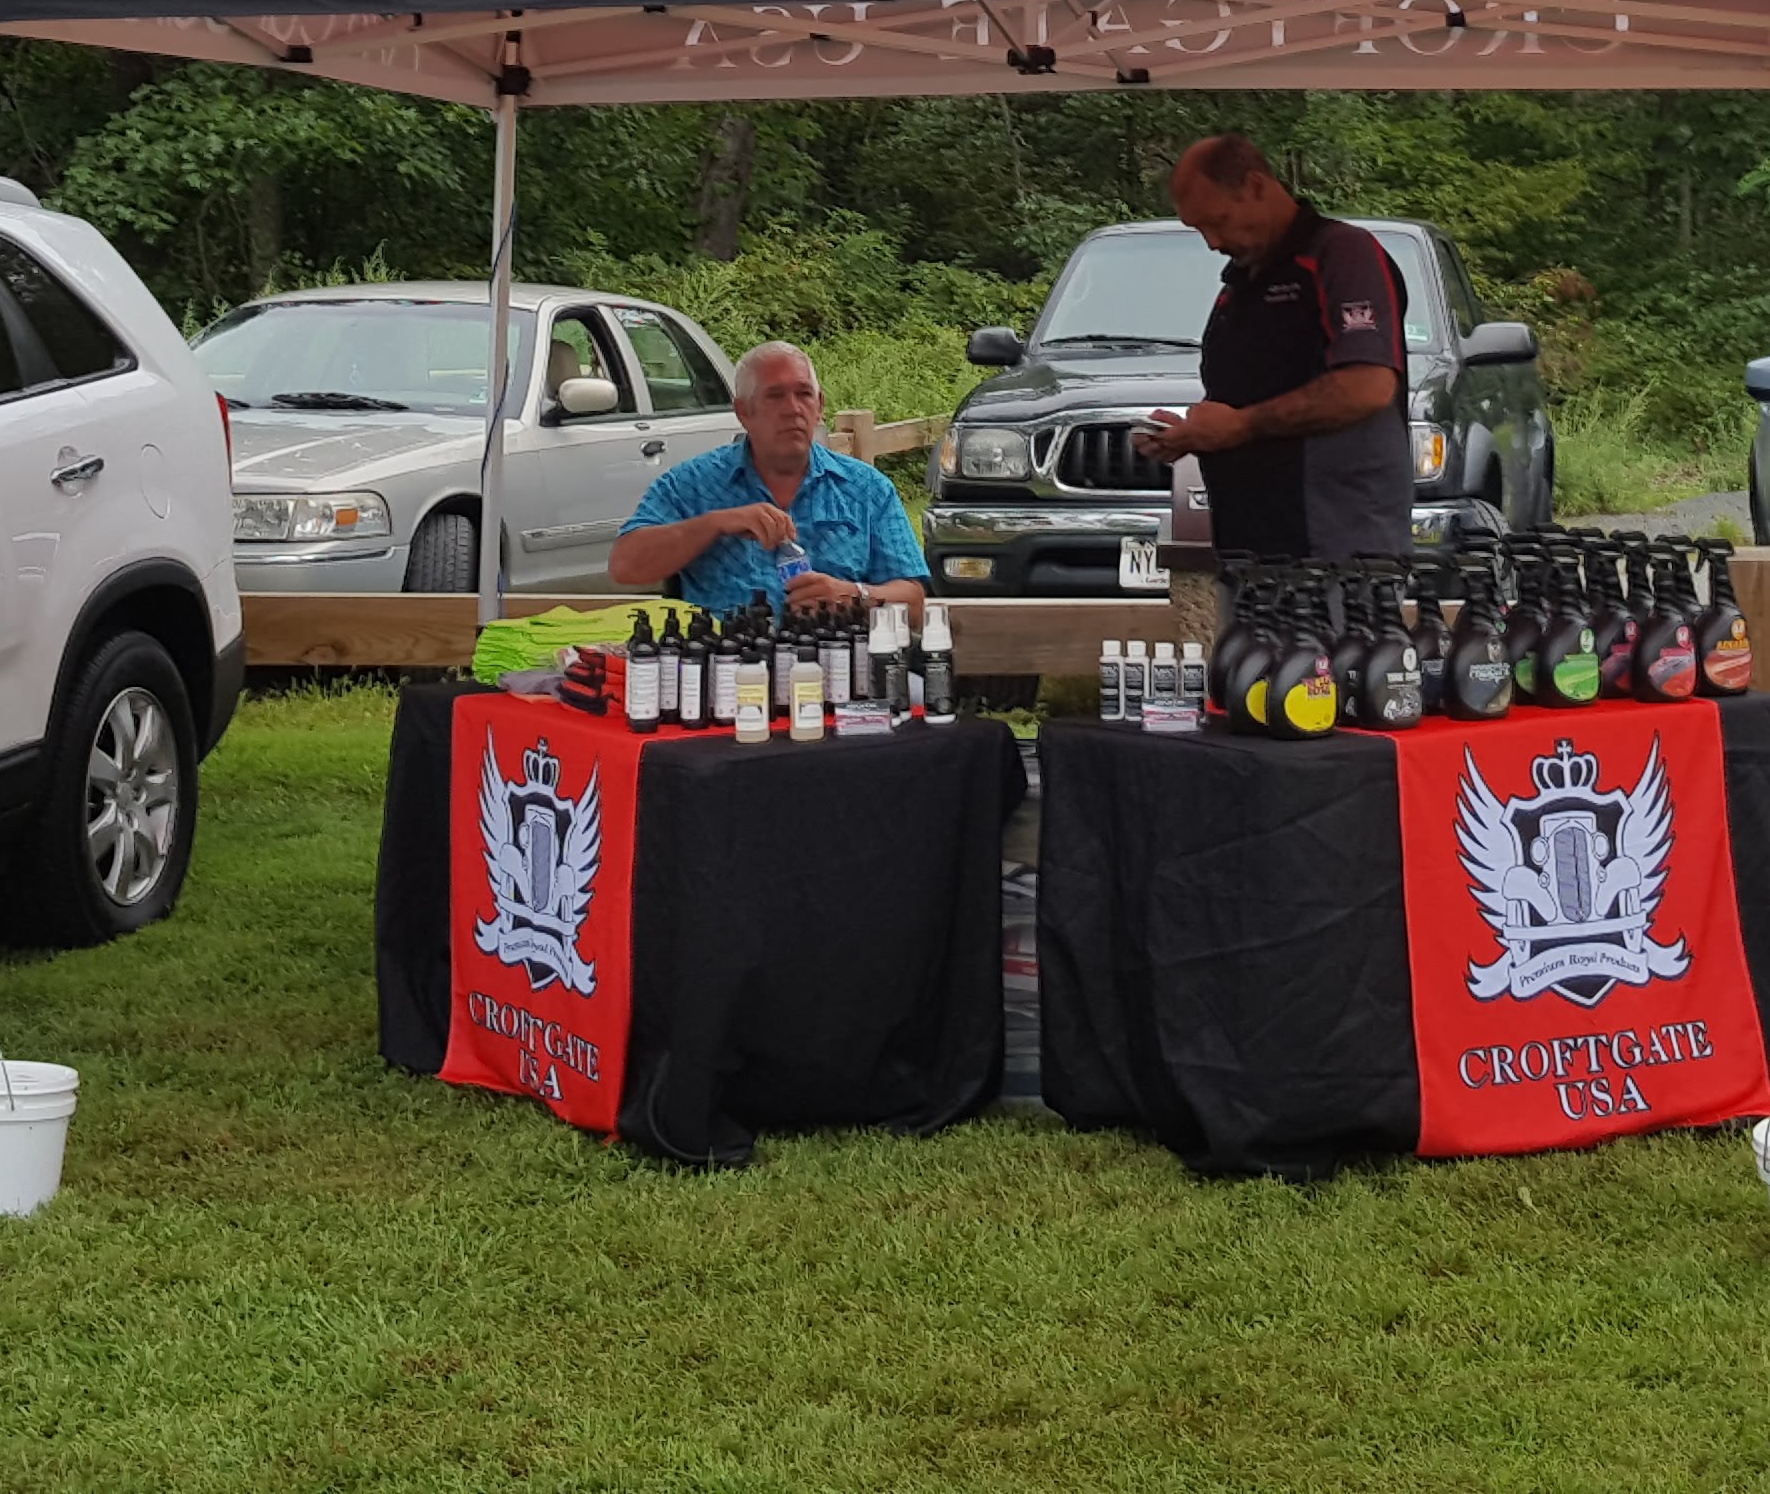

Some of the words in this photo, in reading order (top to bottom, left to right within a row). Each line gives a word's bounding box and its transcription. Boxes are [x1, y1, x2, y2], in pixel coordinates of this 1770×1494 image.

[1519, 959, 1565, 988] Premium
[469, 992, 600, 1083] CROFTGATE
[1458, 1019, 1715, 1089] CROFTGATE
[518, 1048, 563, 1101] USA
[1554, 1073, 1651, 1120] USA
